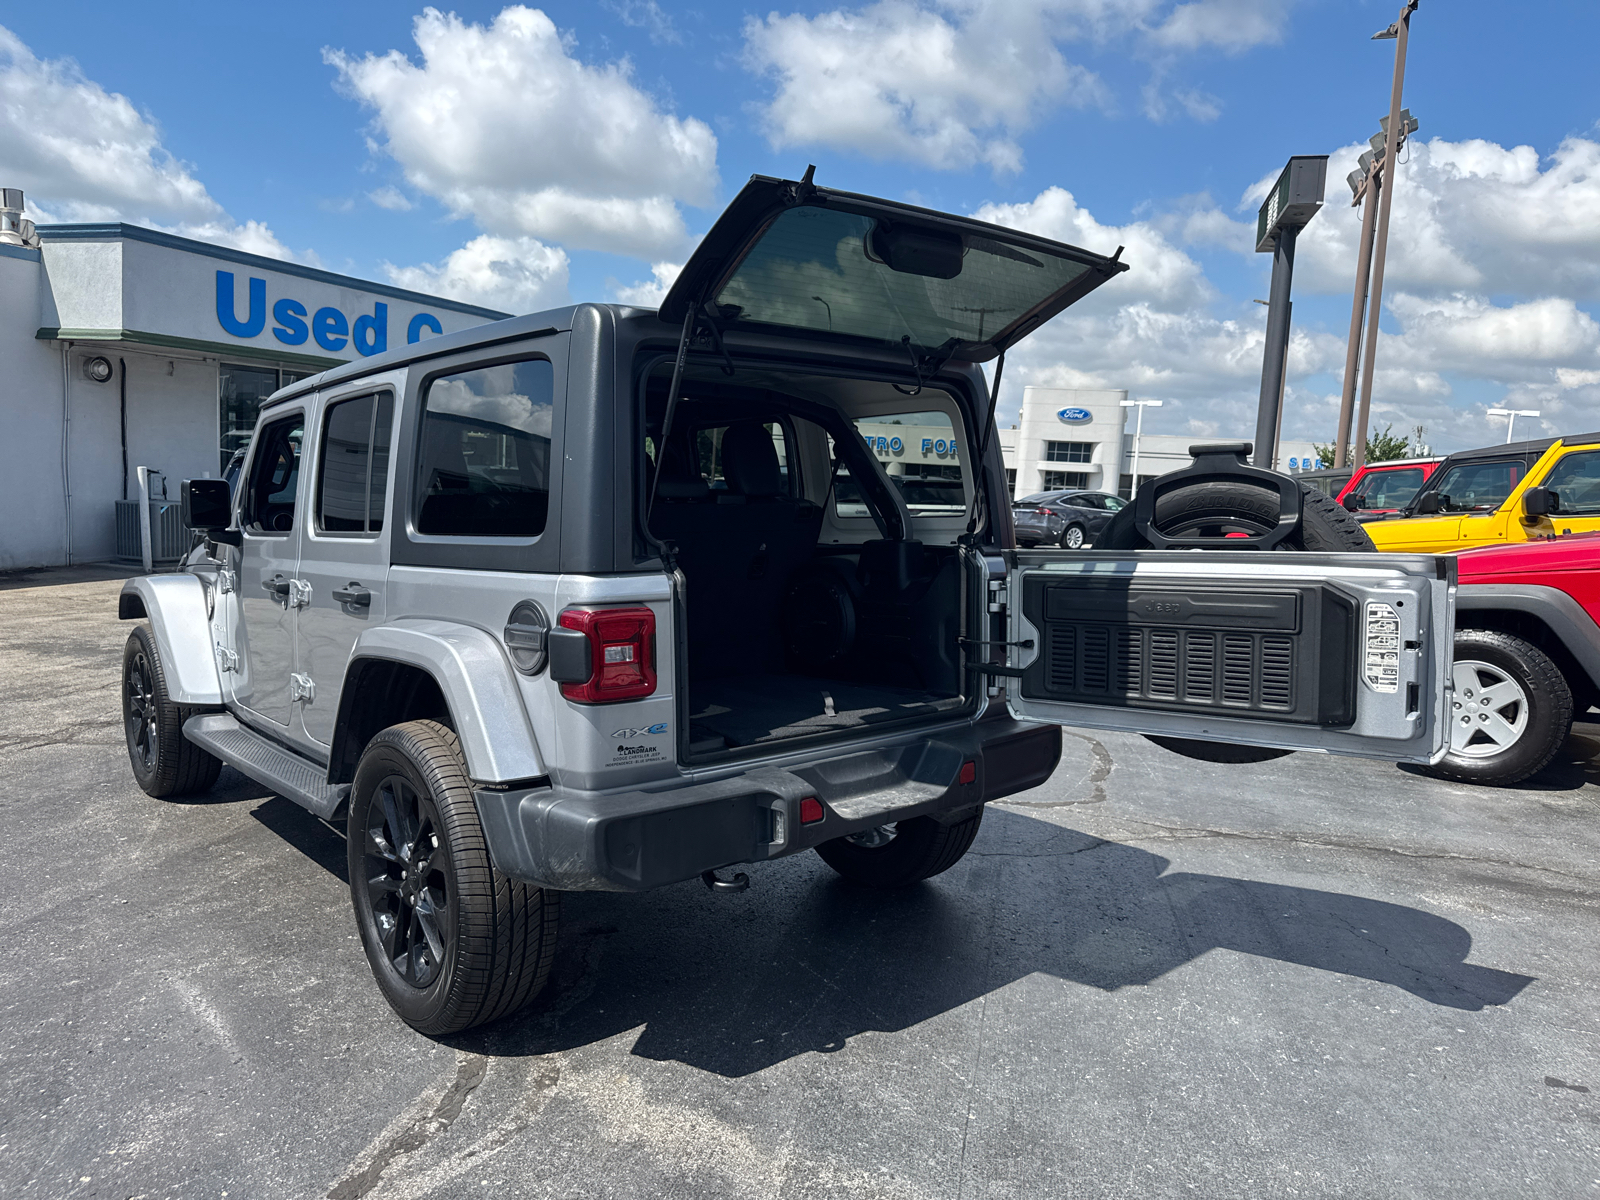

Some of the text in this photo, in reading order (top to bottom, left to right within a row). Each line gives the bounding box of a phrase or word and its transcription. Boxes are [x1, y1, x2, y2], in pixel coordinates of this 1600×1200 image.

[216, 270, 443, 357] Used C
[1063, 409, 1085, 419] Ford
[864, 435, 958, 454] TRO FOR
[1289, 457, 1324, 470] SER
[1185, 494, 1280, 519] BRIDG
[1145, 600, 1181, 615] Jeep
[623, 746, 657, 756] LANDMARK
